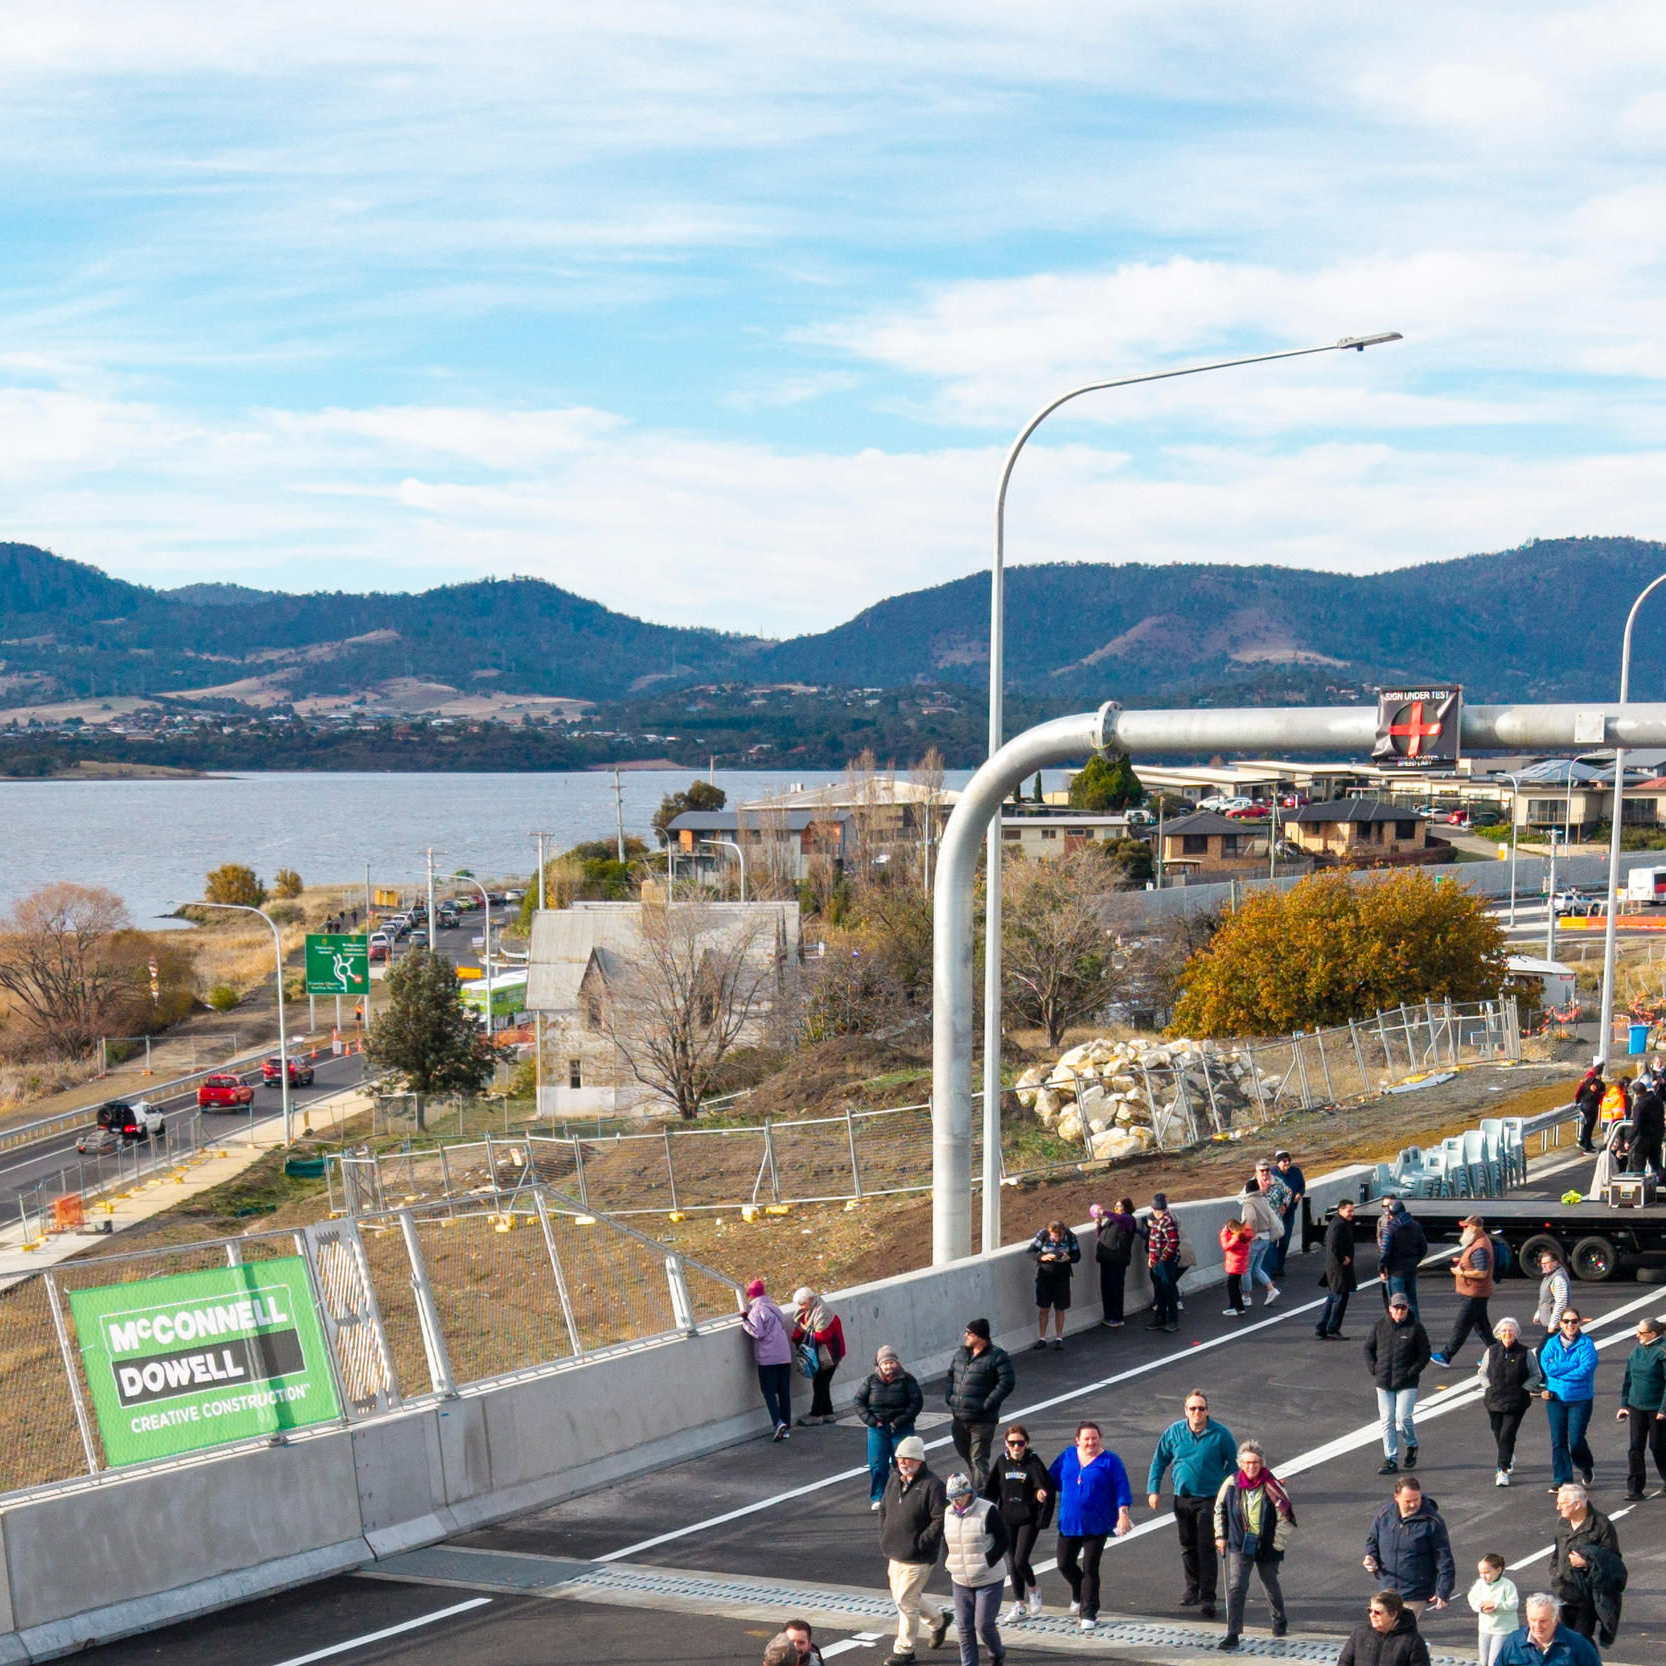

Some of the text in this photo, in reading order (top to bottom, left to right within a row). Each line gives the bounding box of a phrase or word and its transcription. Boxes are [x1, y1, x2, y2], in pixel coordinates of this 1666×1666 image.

[1385, 691, 1449, 701] SIGN UNDER TEST
[119, 1350, 244, 1398] DOWELL
[131, 1405, 200, 1433] CREATIVE
